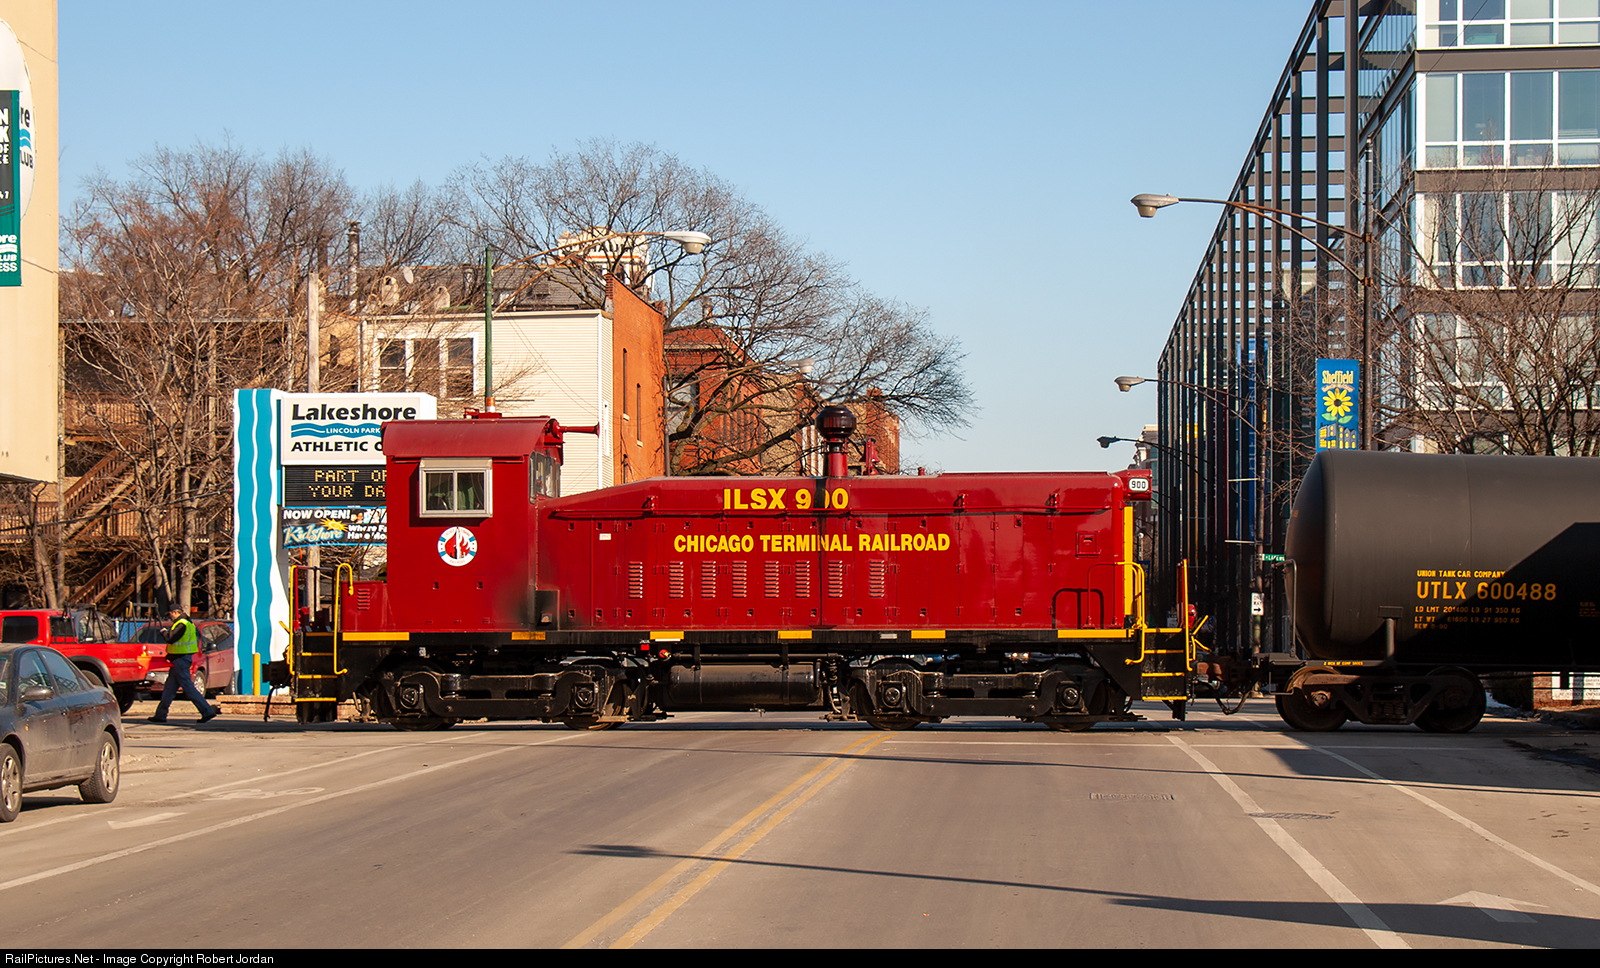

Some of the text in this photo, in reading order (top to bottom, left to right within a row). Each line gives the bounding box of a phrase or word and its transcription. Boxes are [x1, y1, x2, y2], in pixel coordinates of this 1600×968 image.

[1321, 370, 1354, 384] Sheffield
[291, 404, 417, 421] Lakeshore
[291, 441, 369, 452] ATHLETIC
[314, 470, 388, 482] PART OF
[308, 485, 353, 498] YOUR
[1131, 480, 1146, 490] 900
[723, 488, 849, 510] ILSX 90
[283, 509, 351, 520] NOW OPEN!
[674, 533, 950, 553] CHICAGO TERMINAL RAILROAD
[1416, 570, 1437, 578] UNION
[1439, 570, 1456, 578] TANK
[1474, 571, 1506, 579] COMPANY
[1416, 581, 1557, 601] UTLX 600488
